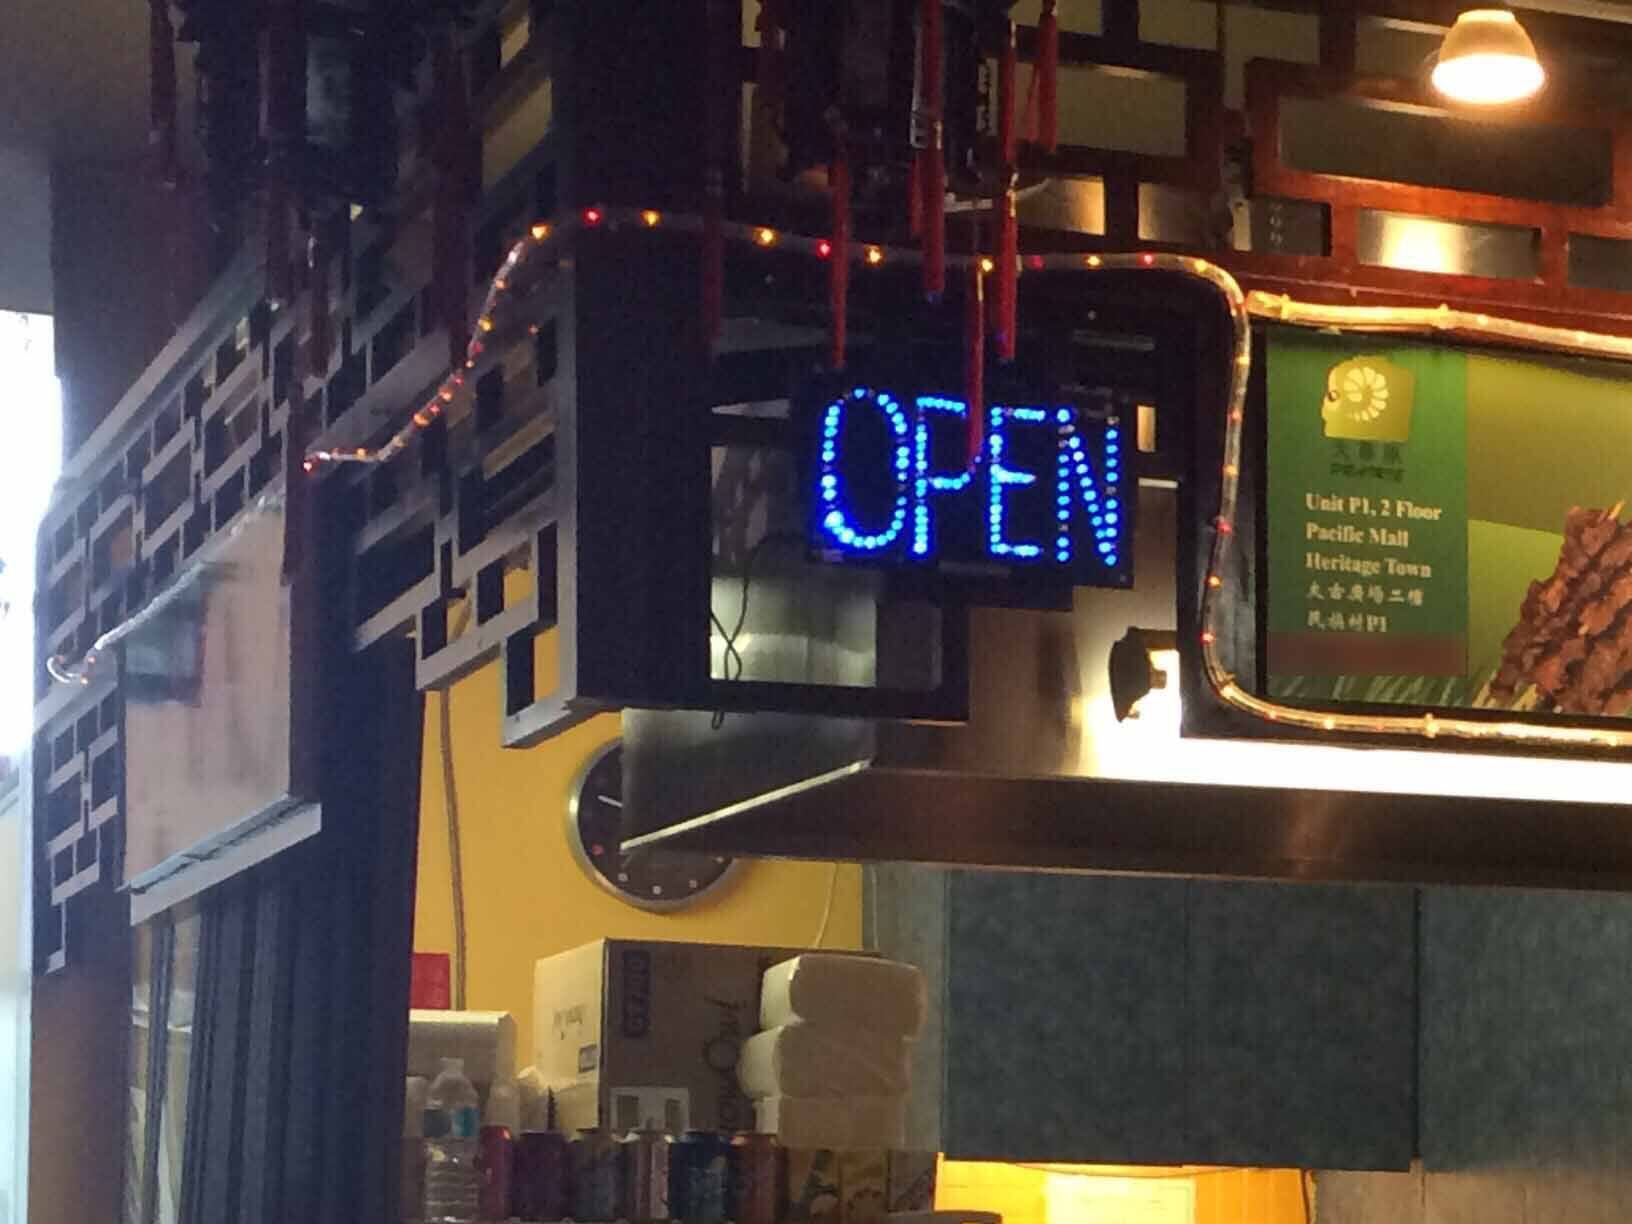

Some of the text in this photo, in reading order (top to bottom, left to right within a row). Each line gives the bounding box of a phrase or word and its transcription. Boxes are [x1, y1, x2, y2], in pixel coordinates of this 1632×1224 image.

[822, 388, 1121, 567] OPEN
[1305, 492, 1345, 514] Unit
[1379, 498, 1391, 517] 2
[1395, 500, 1443, 521] Floor
[1305, 521, 1409, 549] Pacific Mall
[1305, 551, 1432, 579] Heritage Town
